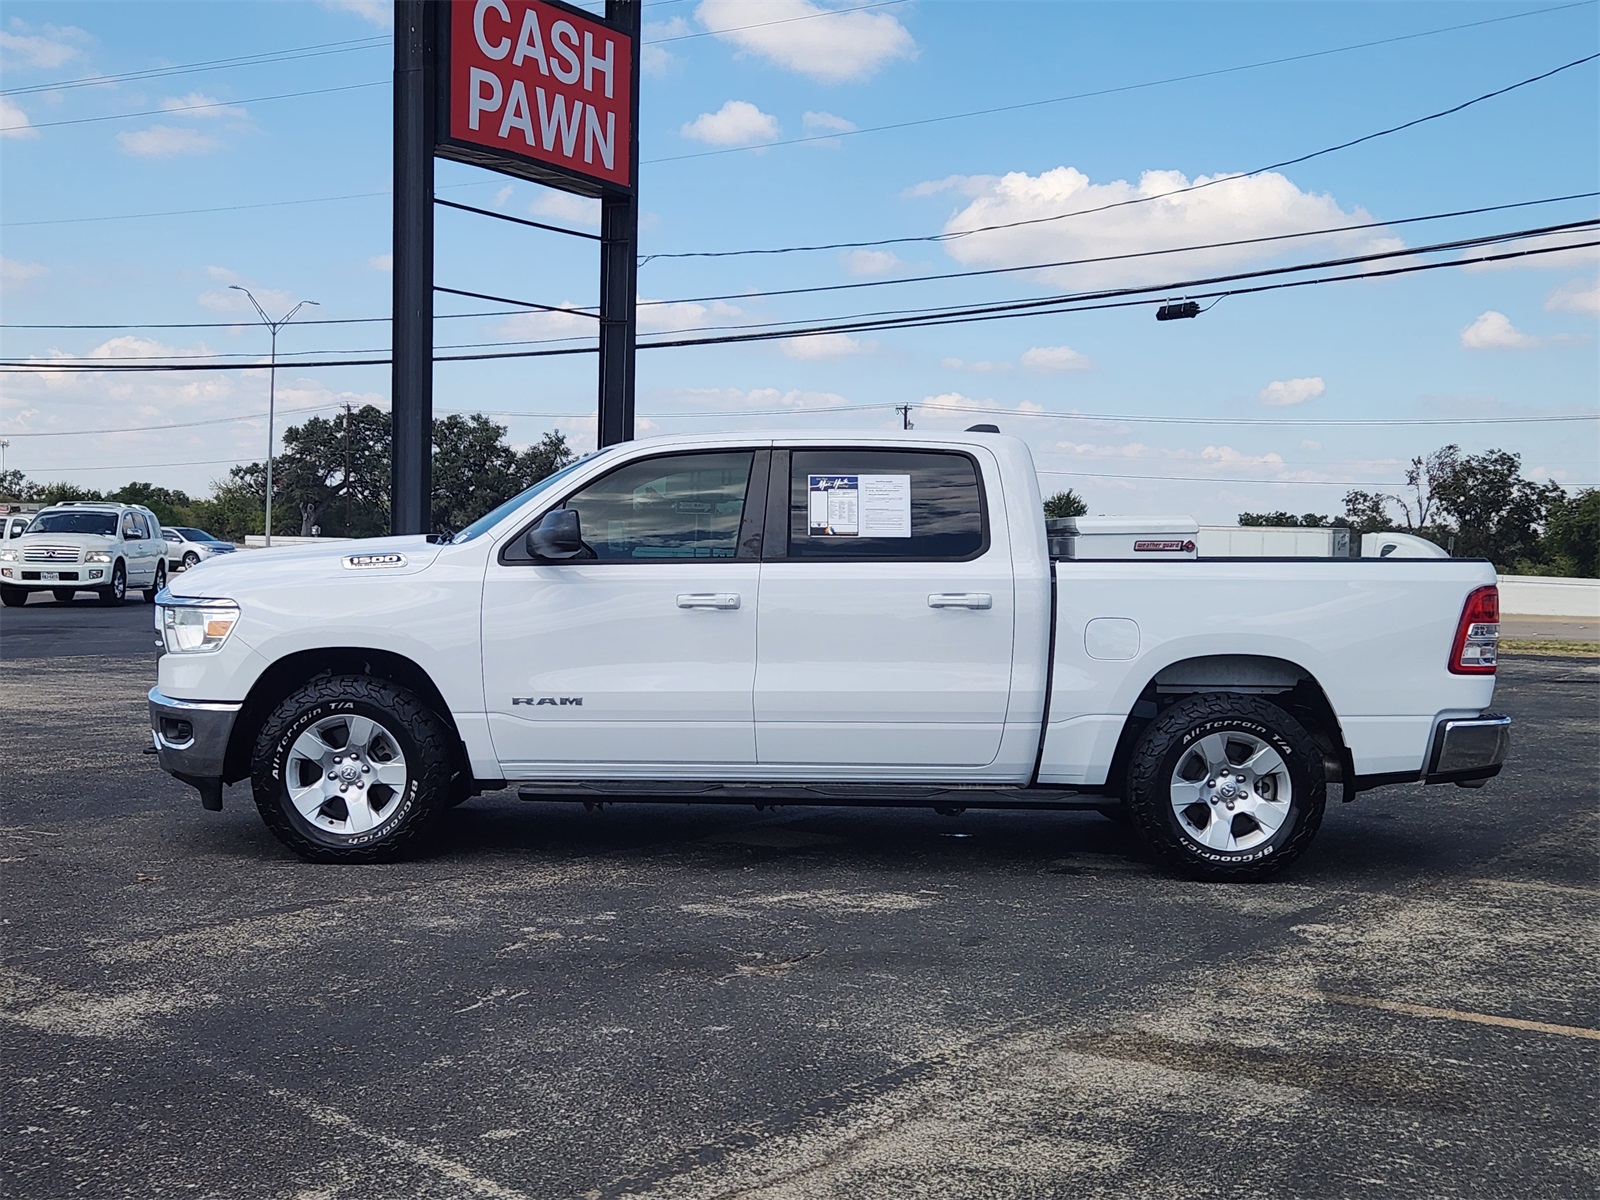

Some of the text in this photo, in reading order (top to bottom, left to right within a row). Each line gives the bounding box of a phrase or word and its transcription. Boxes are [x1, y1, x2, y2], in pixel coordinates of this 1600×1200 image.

[473, 0, 615, 99] CASH
[469, 66, 616, 171] PAWN
[512, 697, 583, 706] RAM
[271, 701, 355, 780] All-Terrain T/A
[1181, 719, 1293, 755] All-Terrain T/A
[347, 779, 419, 845] BFGoodrich
[1178, 837, 1274, 863] BFGoodrich
